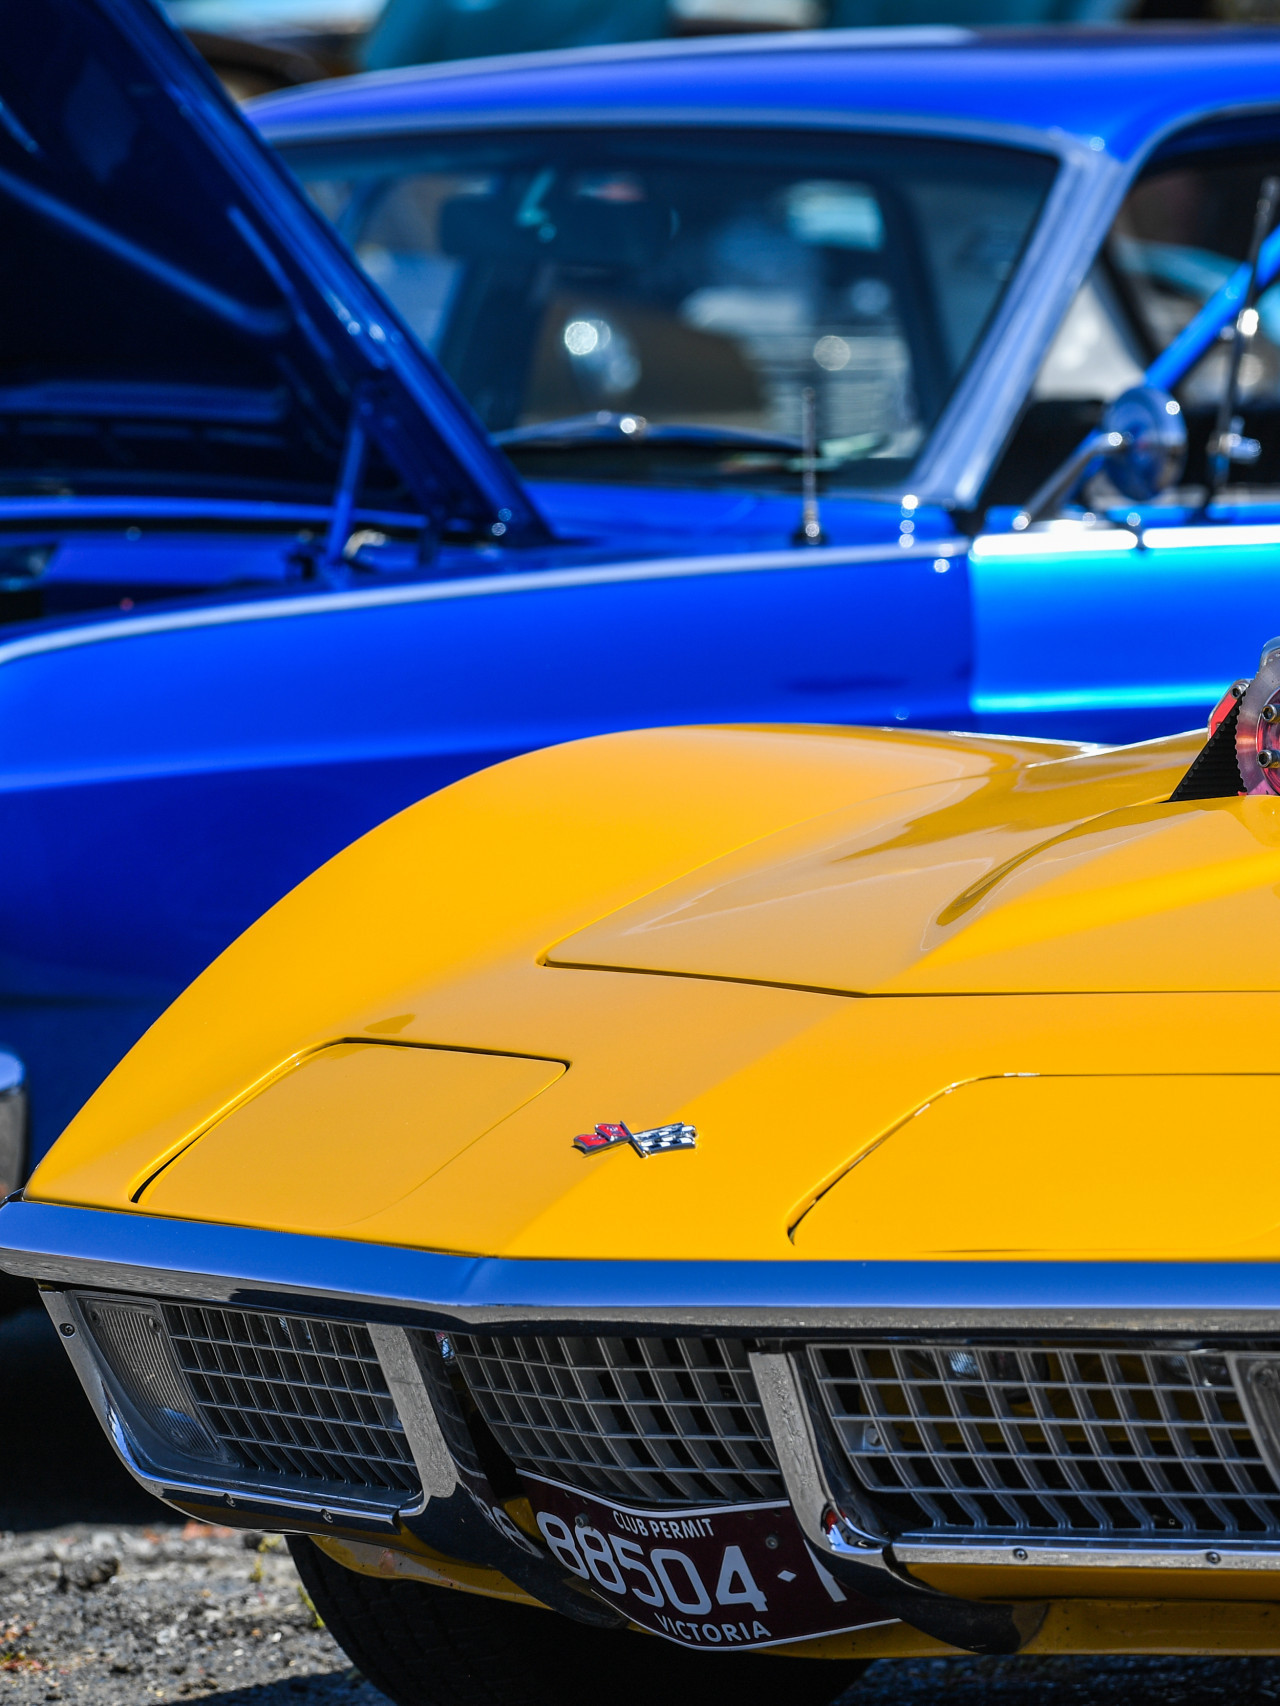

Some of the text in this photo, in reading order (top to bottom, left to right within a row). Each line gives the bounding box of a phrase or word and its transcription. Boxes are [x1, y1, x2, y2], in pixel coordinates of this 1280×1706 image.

[612, 1510, 714, 1539] CLUB PERMIT
[536, 1511, 769, 1615] 88504
[653, 1612, 772, 1643] VICTORIA
